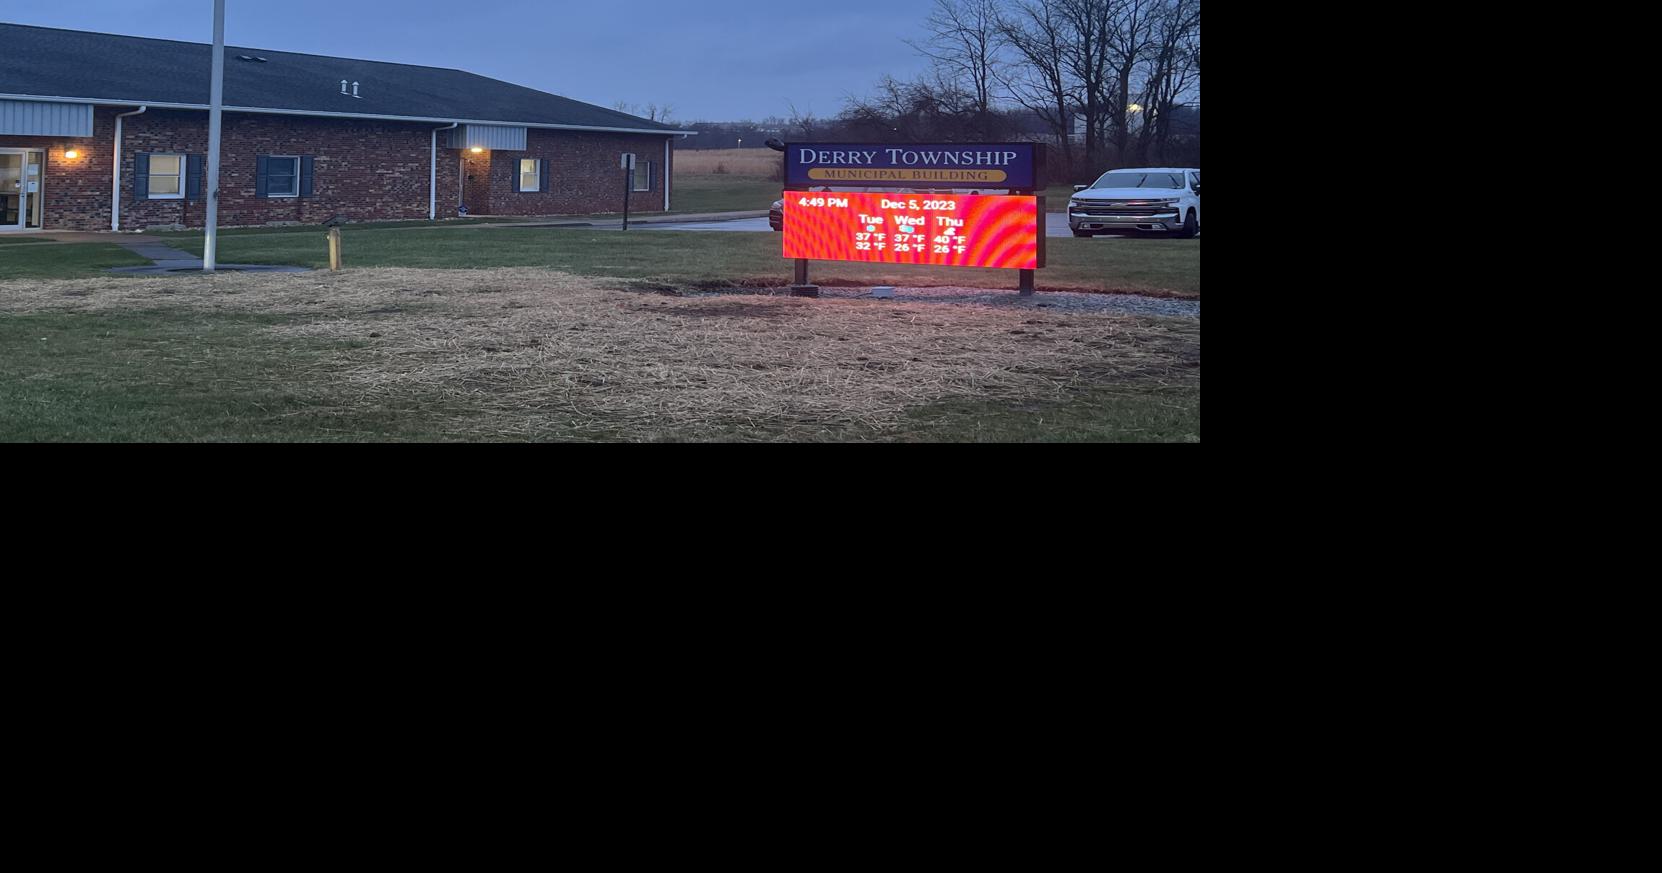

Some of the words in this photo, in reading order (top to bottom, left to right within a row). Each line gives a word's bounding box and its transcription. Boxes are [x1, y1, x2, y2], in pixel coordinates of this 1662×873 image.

[800, 148, 877, 165] DERRY
[886, 148, 1017, 166] TOWNSHIP
[824, 169, 906, 180] MUNICIPAL
[912, 170, 988, 181] BUILDING
[799, 197, 825, 207] 4:49
[828, 198, 848, 208] PM
[881, 199, 906, 210] Dec
[909, 199, 919, 211] 5,
[923, 200, 956, 211] 2023
[859, 214, 884, 224] Tue
[894, 215, 925, 226] Wed
[936, 216, 963, 227] Thu
[856, 232, 871, 241] 37
[894, 234, 910, 242] 37
[934, 235, 950, 244] 40
[856, 242, 871, 250] 32
[894, 243, 910, 252] 26
[934, 244, 950, 253] 26
